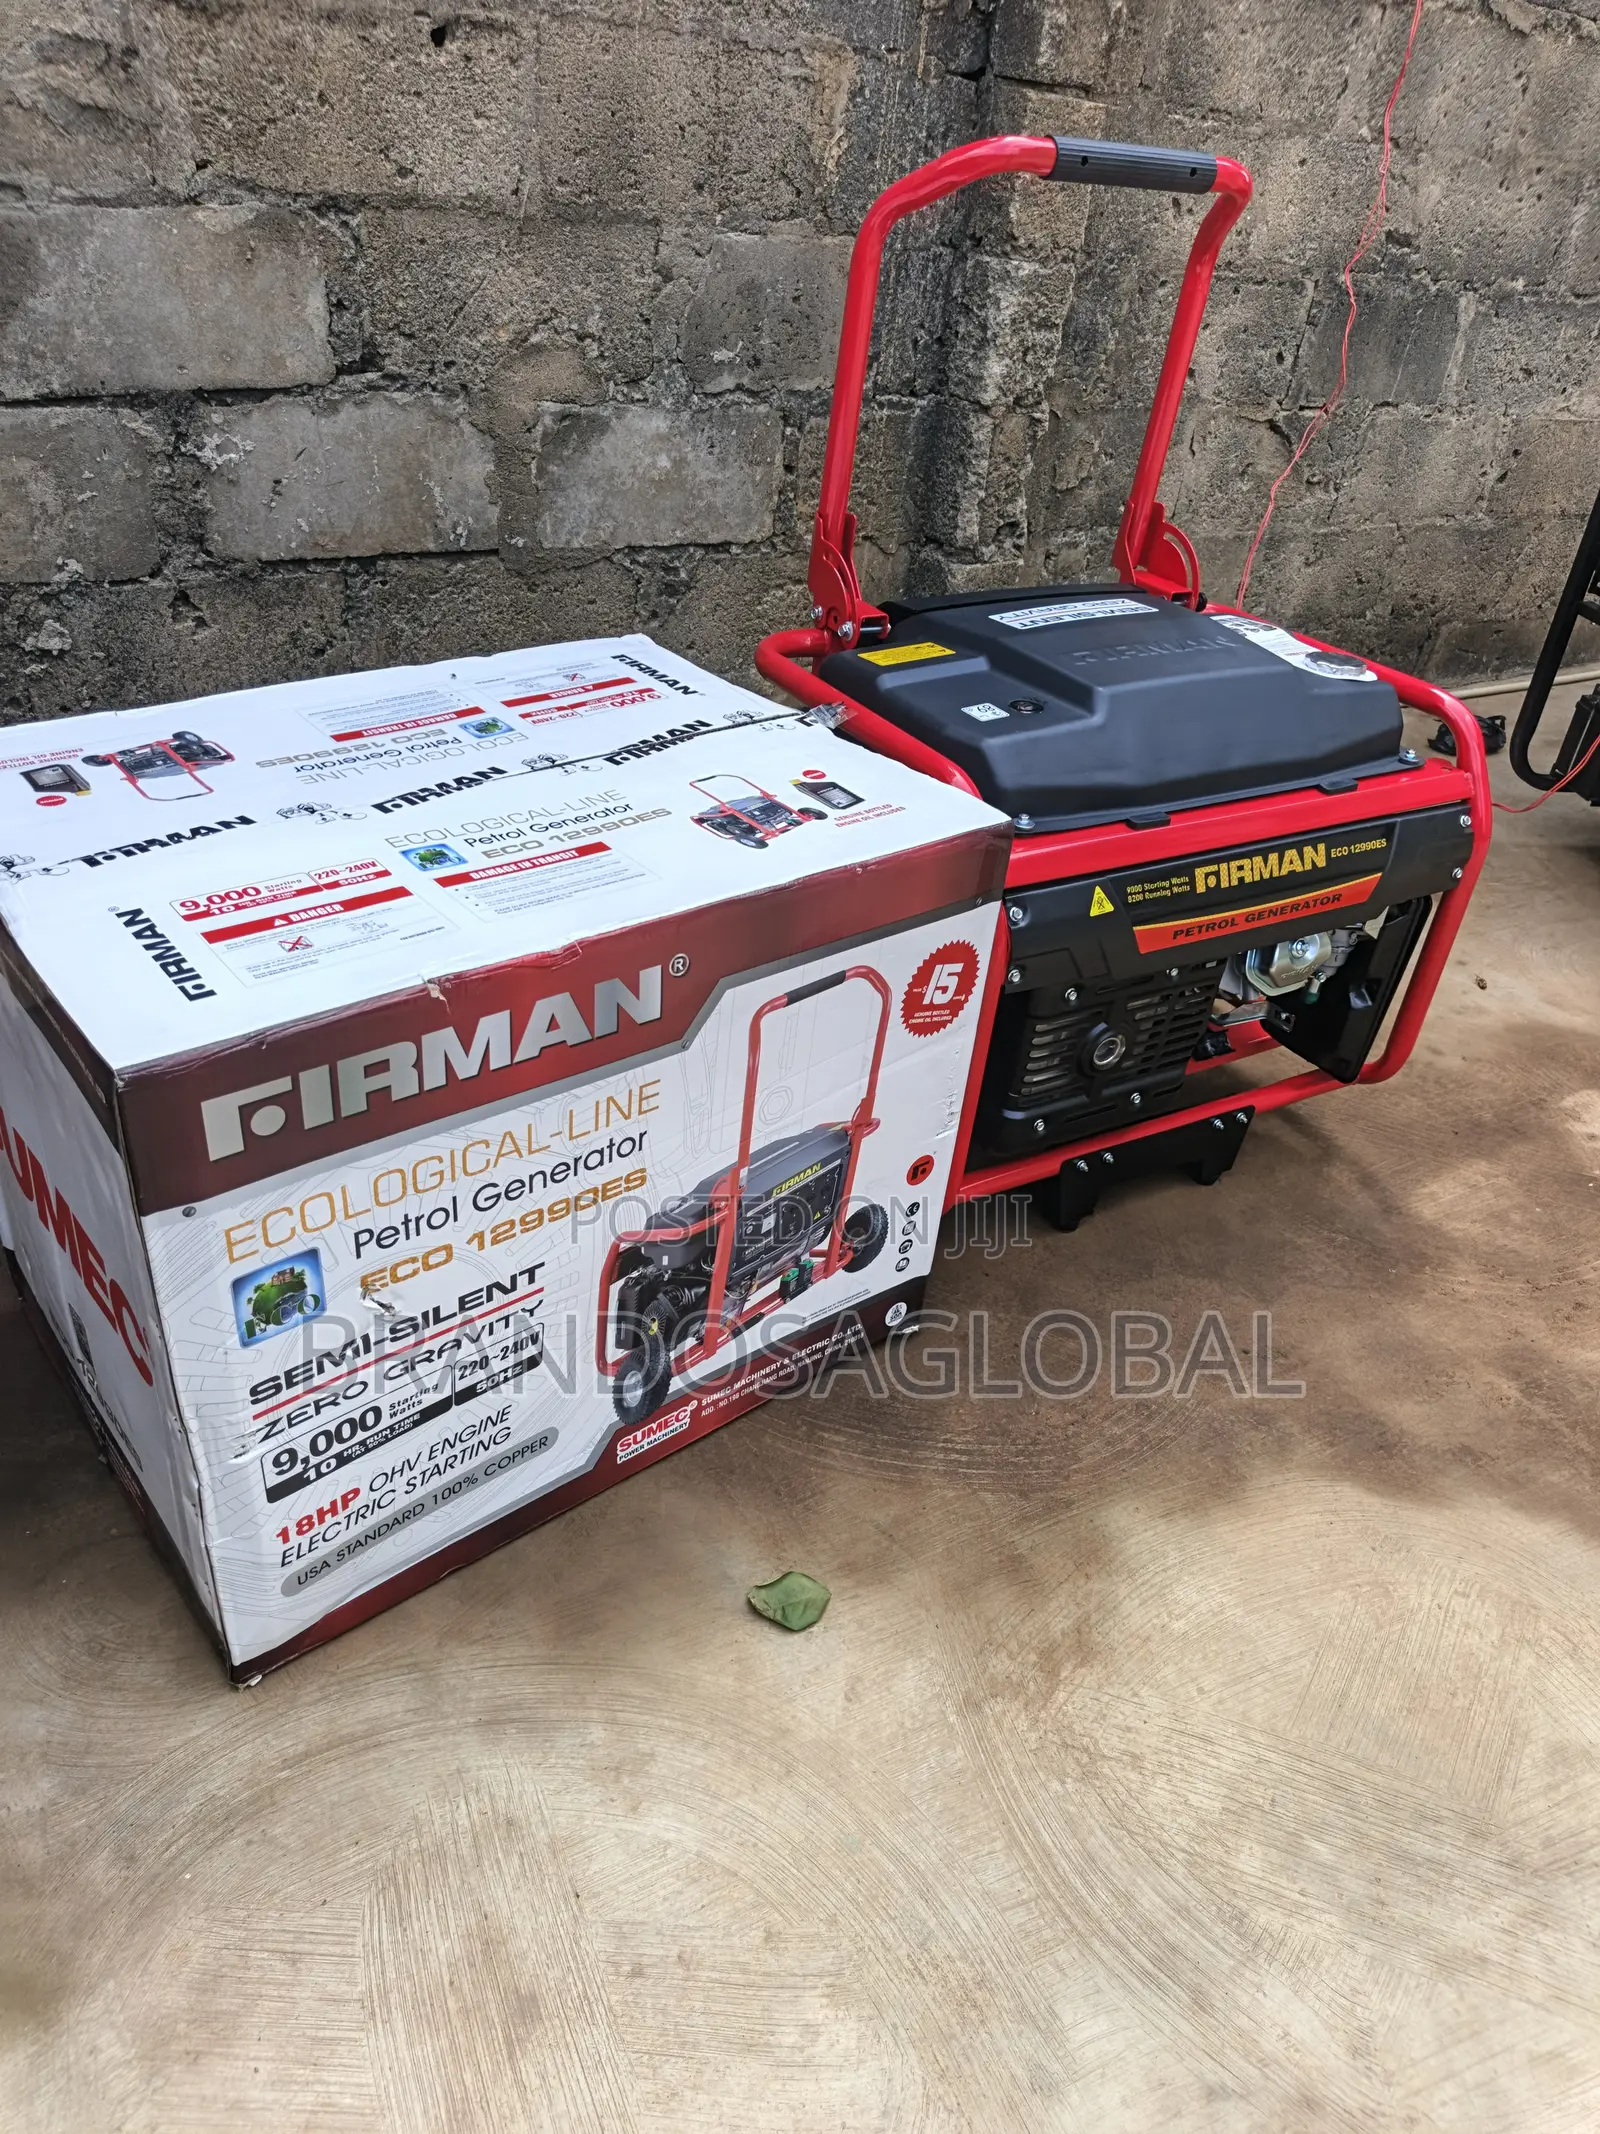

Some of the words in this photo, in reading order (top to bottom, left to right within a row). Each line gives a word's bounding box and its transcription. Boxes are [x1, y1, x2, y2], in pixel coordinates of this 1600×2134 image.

[611, 654, 699, 696] FIRMAN
[296, 732, 529, 784] ECOLOGICAL-LINE
[391, 728, 448, 745] ECO
[406, 736, 462, 754] Petrol
[296, 749, 402, 774] Generator
[384, 789, 627, 848] ECOLOGICAL-LINE
[464, 827, 527, 847] Petrol
[529, 801, 634, 833] Generator
[481, 840, 544, 859] ECO
[548, 807, 672, 843] 12990ES
[469, 862, 521, 880] DAMAGE
[520, 859, 535, 868] IN
[532, 850, 580, 866] TRANSIT
[1194, 842, 1327, 894] FIRMAN
[1331, 847, 1347, 858] ECO
[1349, 838, 1387, 854] 12990ES
[179, 886, 262, 913] 9,000
[1143, 878, 1170, 892] Starting
[1144, 888, 1171, 900] Running
[208, 904, 236, 917] 10
[291, 904, 344, 922] DANGER
[1172, 915, 1238, 940] PETROL
[1245, 893, 1342, 923] GENERATOR
[115, 908, 217, 1002] FIRMAN
[200, 964, 662, 1162] FIRMAN
[224, 1079, 661, 1264] ECOLOGICAL-LINE
[355, 1197, 459, 1259] Petrol
[472, 1130, 647, 1212] Generator
[772, 1163, 821, 1197] FIRMAN
[0, 1108, 153, 1388] UMEC
[360, 1243, 454, 1289] ECO
[466, 1168, 647, 1252] 12990ES
[249, 1262, 546, 1406] SEMI-SILENT
[258, 1380, 369, 1444] ZERO
[383, 1299, 544, 1382] GRAVITY
[701, 1386, 732, 1406] SUMEC
[733, 1360, 782, 1390] MACHINERY
[783, 1356, 790, 1364] &
[792, 1337, 830, 1361] ELECTRIC
[271, 1404, 382, 1477] 9,000
[388, 1382, 439, 1411] Starting
[388, 1422, 413, 1438] LOAD)
[389, 1398, 424, 1421] Watts
[618, 1406, 691, 1453] SUMEC
[304, 1458, 337, 1482] 10
[366, 1428, 391, 1445] RUN
[393, 1412, 421, 1430] TIME
[619, 1444, 645, 1462] POWER
[647, 1421, 689, 1448] MACHINERY
[275, 1487, 361, 1544] 18HP
[369, 1451, 422, 1493] OHV
[428, 1404, 513, 1462] ENGINE
[281, 1489, 397, 1568] ELECTRIC
[404, 1426, 512, 1495] STARTING
[297, 1560, 331, 1585] USA
[336, 1503, 425, 1563] STANDARD
[432, 1473, 478, 1506] 100%
[484, 1435, 549, 1478] COPPER
